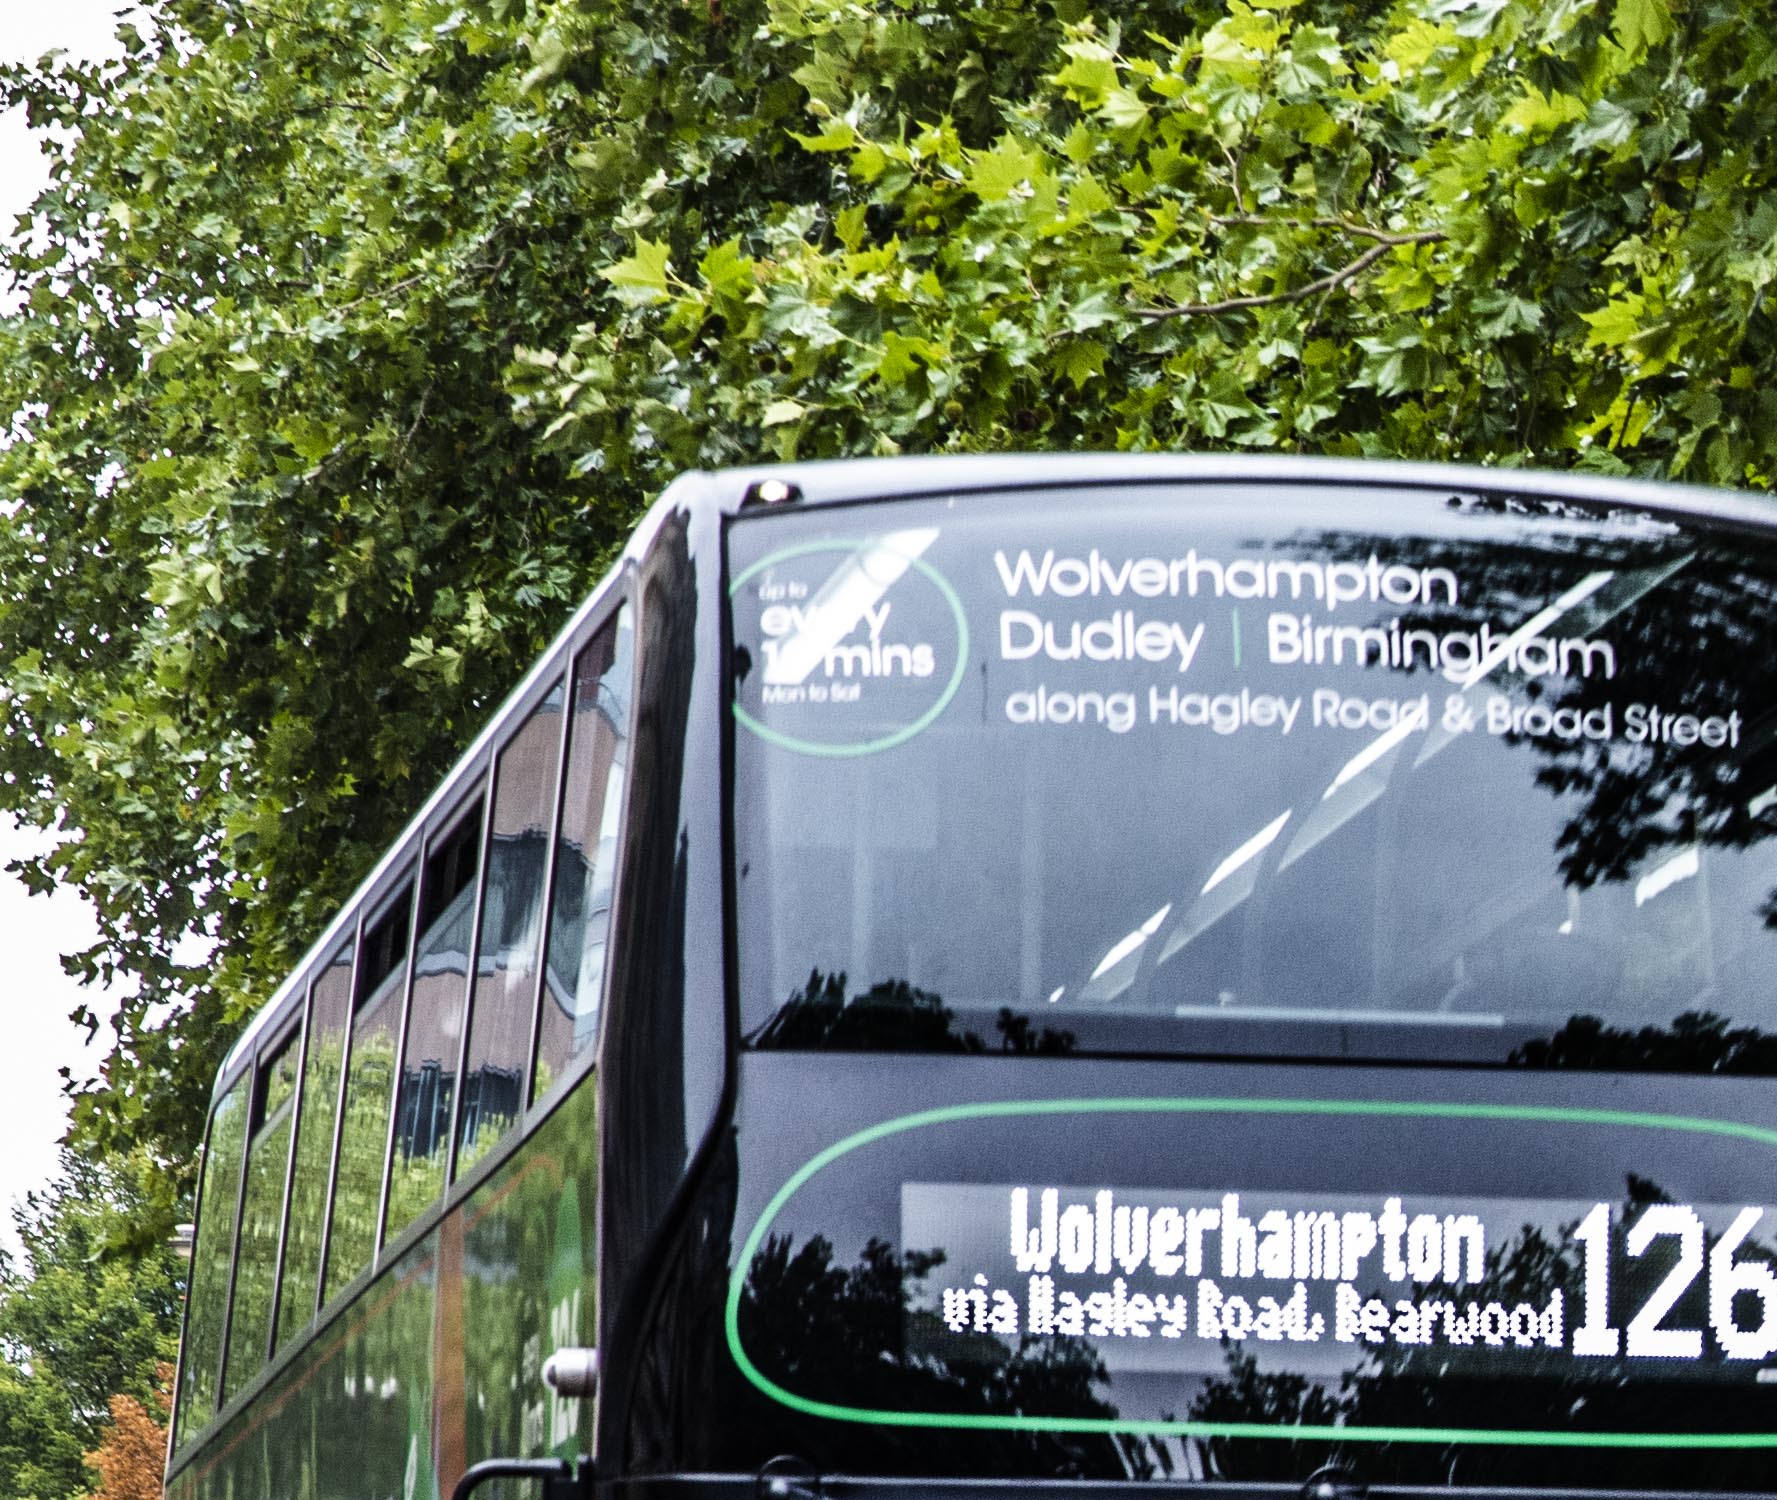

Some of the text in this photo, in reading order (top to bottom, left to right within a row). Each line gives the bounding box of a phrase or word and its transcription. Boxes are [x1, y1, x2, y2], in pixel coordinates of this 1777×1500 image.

[994, 549, 1458, 611] Wolverhampton
[999, 610, 1617, 683] Dudley Birmingham
[1005, 683, 1743, 749] along Hagley Road & Broad Street
[1010, 1187, 1485, 1283] Wolverhampton
[943, 1273, 1018, 1335] via
[1029, 1275, 1188, 1338] Hagley
[1335, 1282, 1564, 1348] Bearwood
